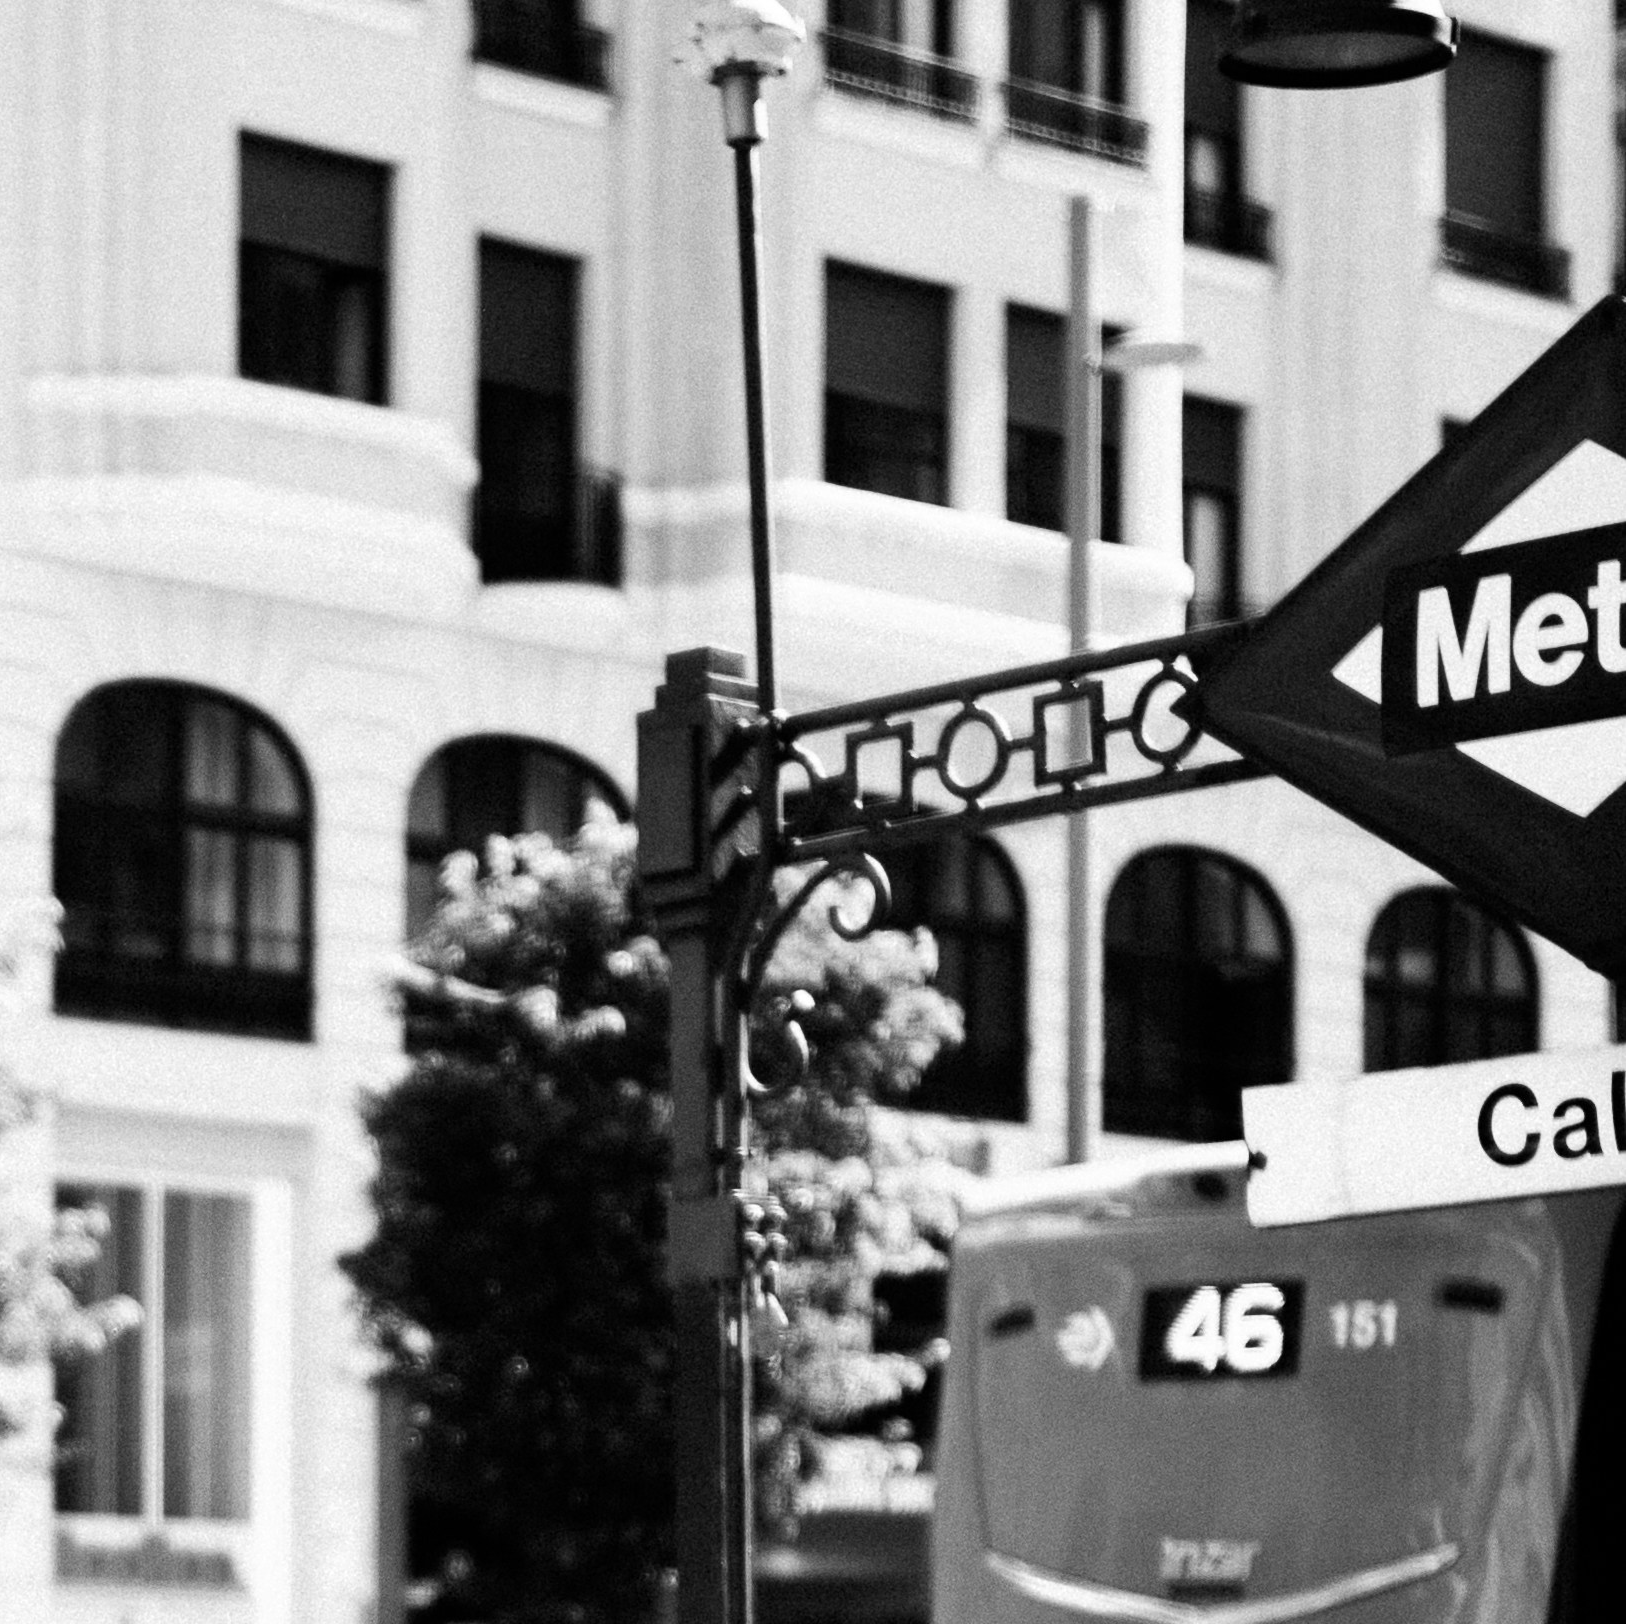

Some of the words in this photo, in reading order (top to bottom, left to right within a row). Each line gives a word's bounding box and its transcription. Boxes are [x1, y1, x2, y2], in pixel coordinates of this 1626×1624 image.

[1416, 559, 1626, 708] Met
[1478, 1070, 1626, 1167] Cal
[1167, 1282, 1285, 1373] 46
[1330, 1300, 1398, 1350] 151
